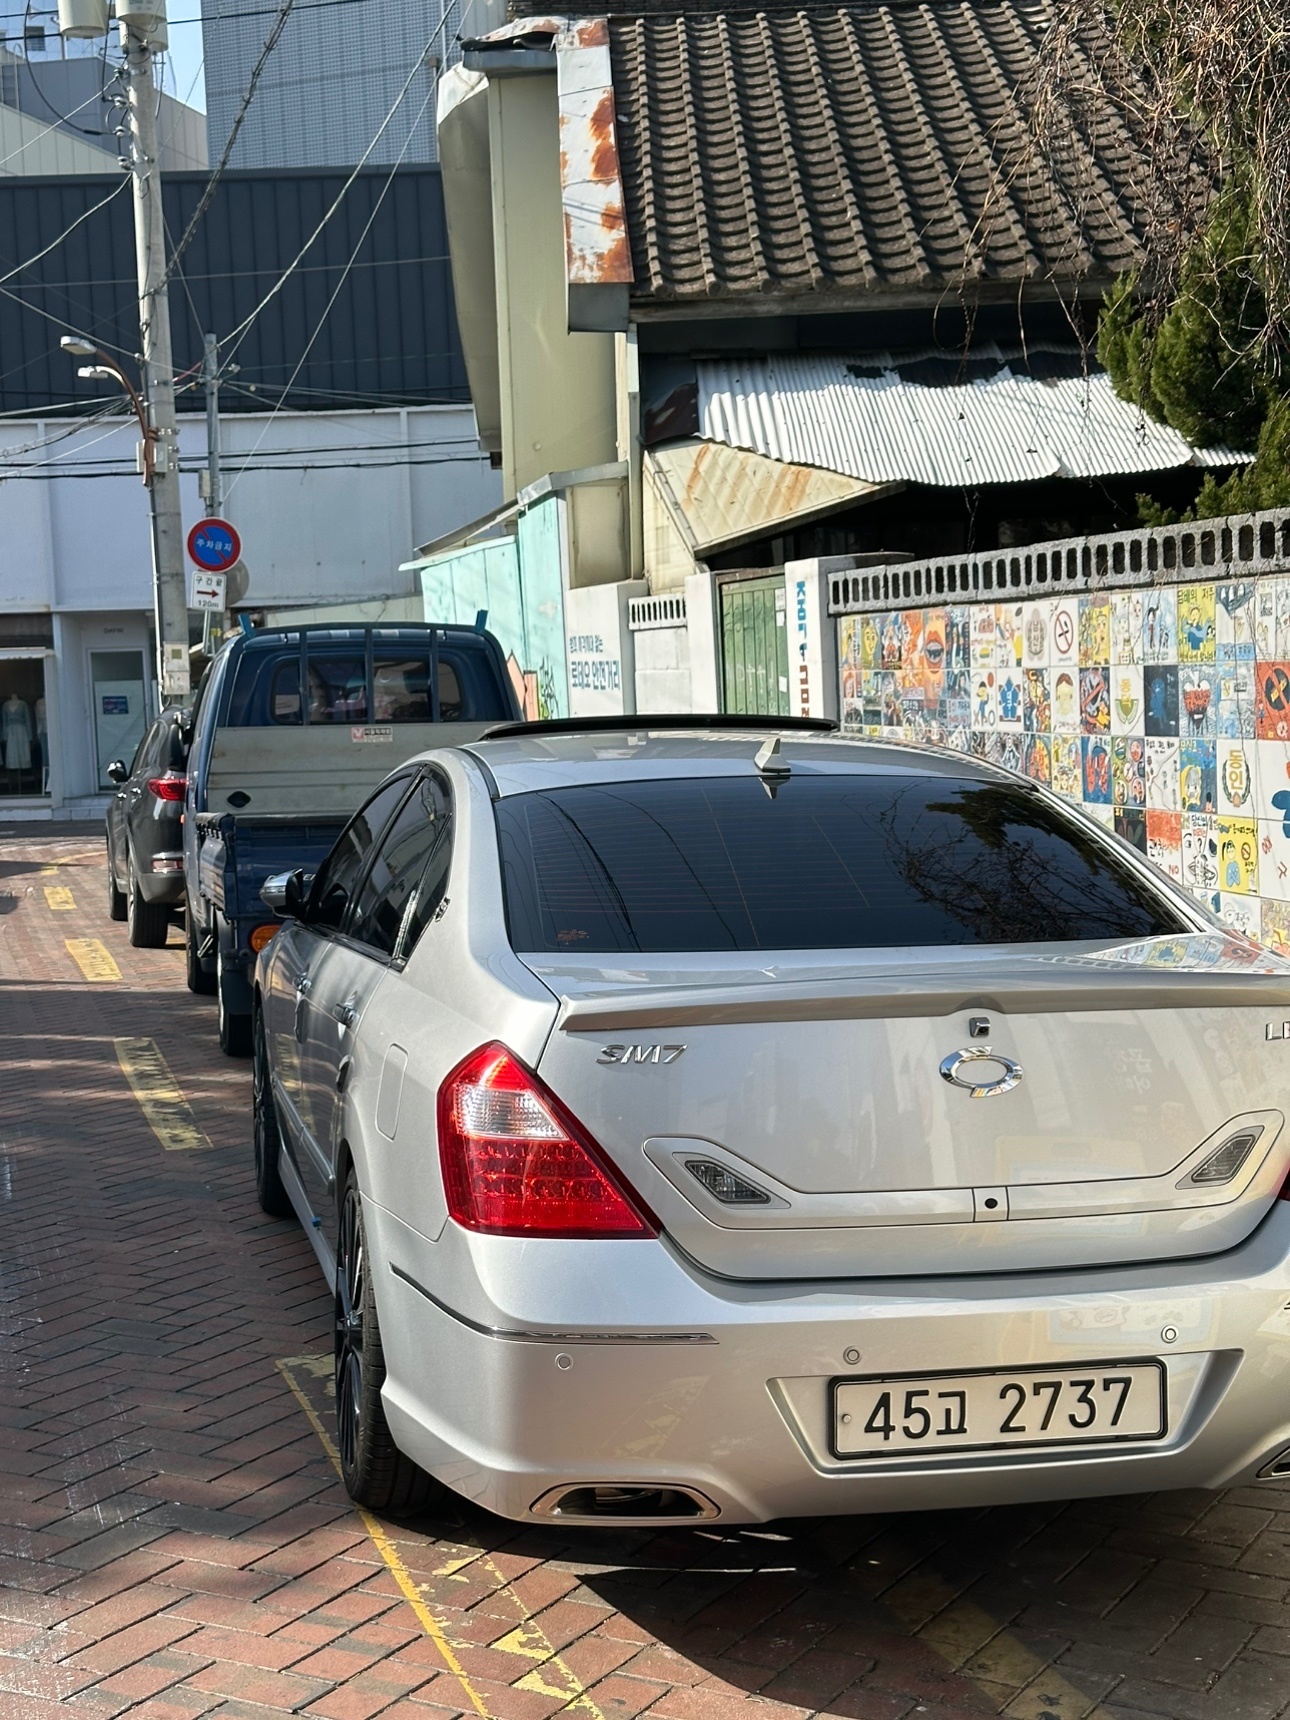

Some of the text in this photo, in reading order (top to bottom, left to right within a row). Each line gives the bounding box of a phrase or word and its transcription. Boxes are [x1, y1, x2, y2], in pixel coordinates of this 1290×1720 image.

[196, 538, 232, 551] 주차금지
[198, 600, 220, 608] 120m
[571, 660, 591, 689] 로데오
[1228, 749, 1244, 790] 동인
[1168, 864, 1180, 875] NO
[596, 1044, 688, 1065] SM7
[864, 1376, 1133, 1441] 45고 2737
